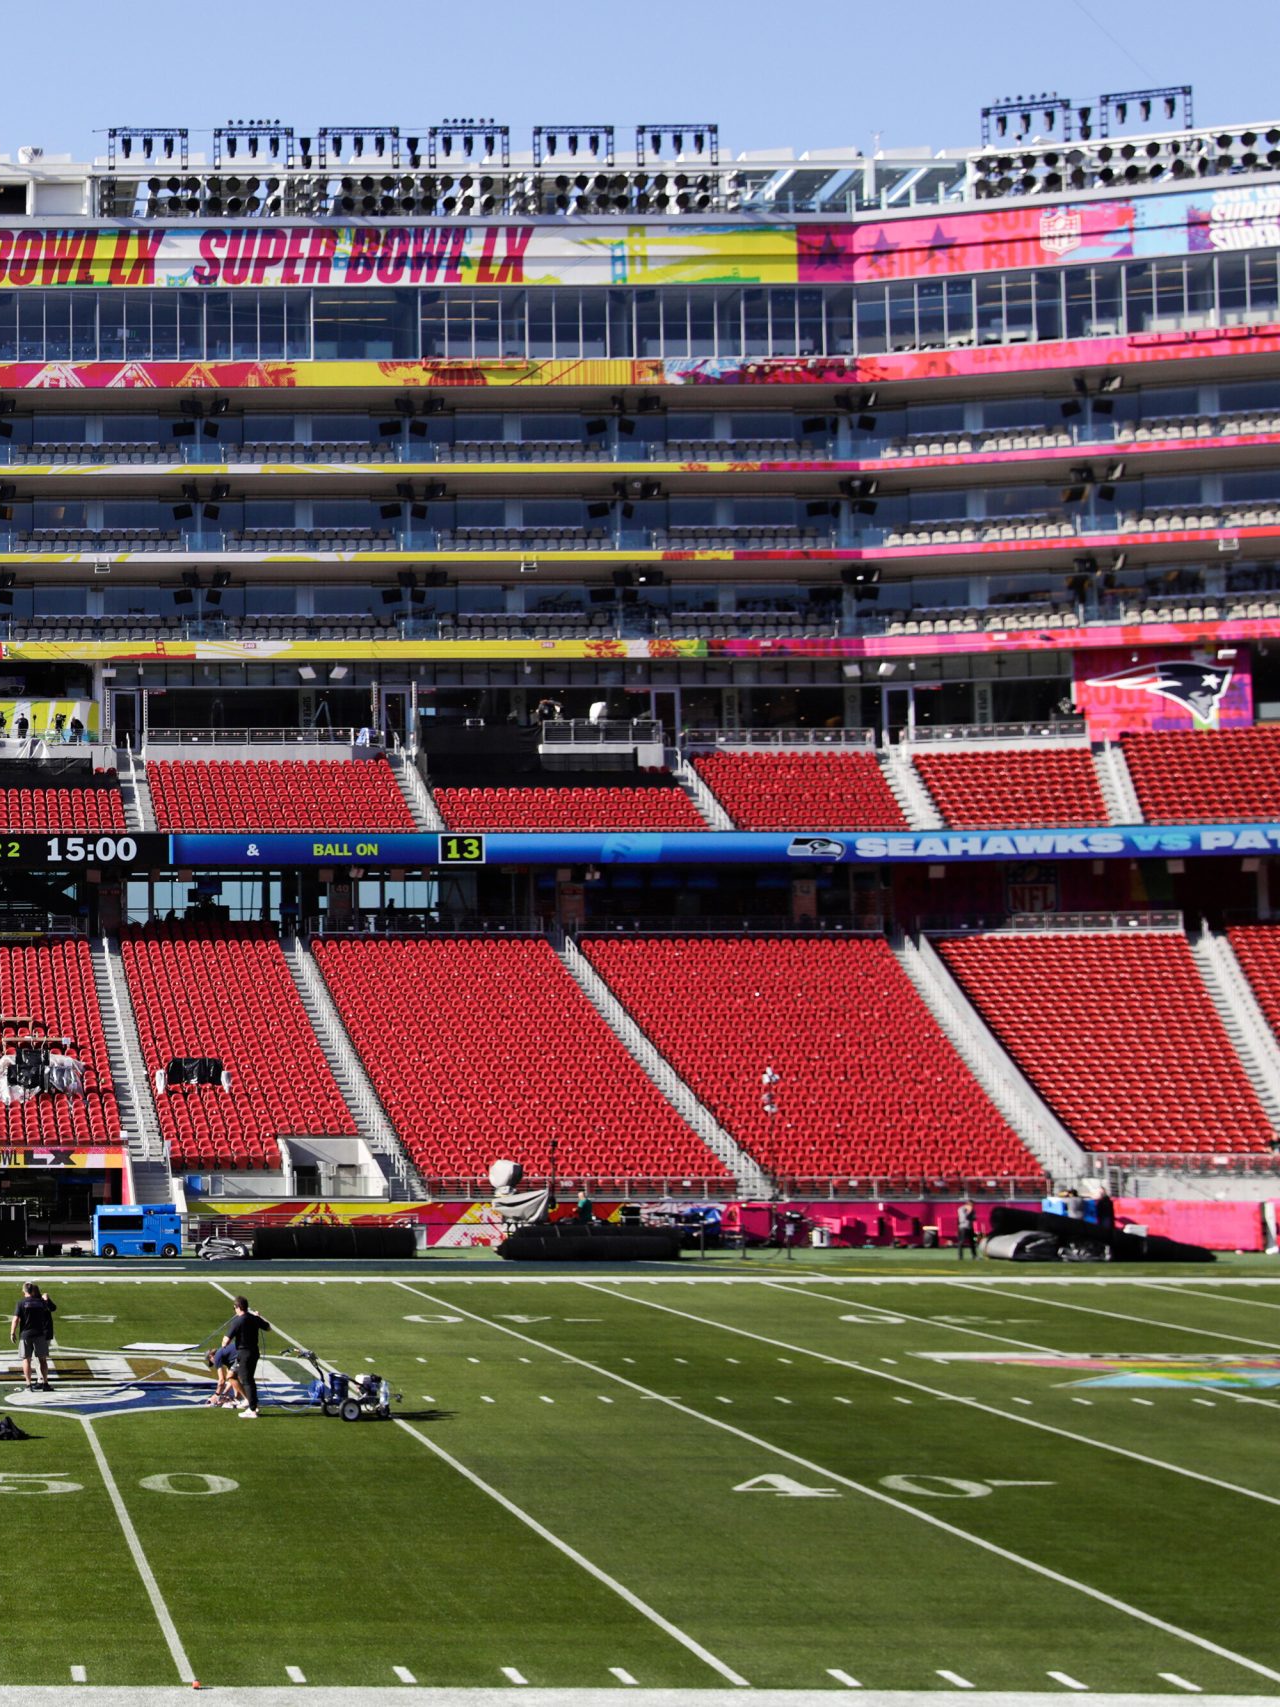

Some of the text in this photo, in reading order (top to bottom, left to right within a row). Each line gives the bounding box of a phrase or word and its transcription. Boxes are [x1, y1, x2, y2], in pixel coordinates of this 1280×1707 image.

[108, 229, 167, 286] LX
[192, 227, 535, 286] SUPER BOWL LX
[7, 841, 20, 858] 2
[46, 838, 137, 862] 15:00
[246, 843, 260, 857] &
[313, 842, 378, 857] BALL ON
[446, 838, 480, 859] 13
[855, 833, 1125, 857] SEAHAWKS
[1132, 833, 1192, 852] VS
[1007, 885, 1052, 912] NFL
[24, 1149, 77, 1166] LX
